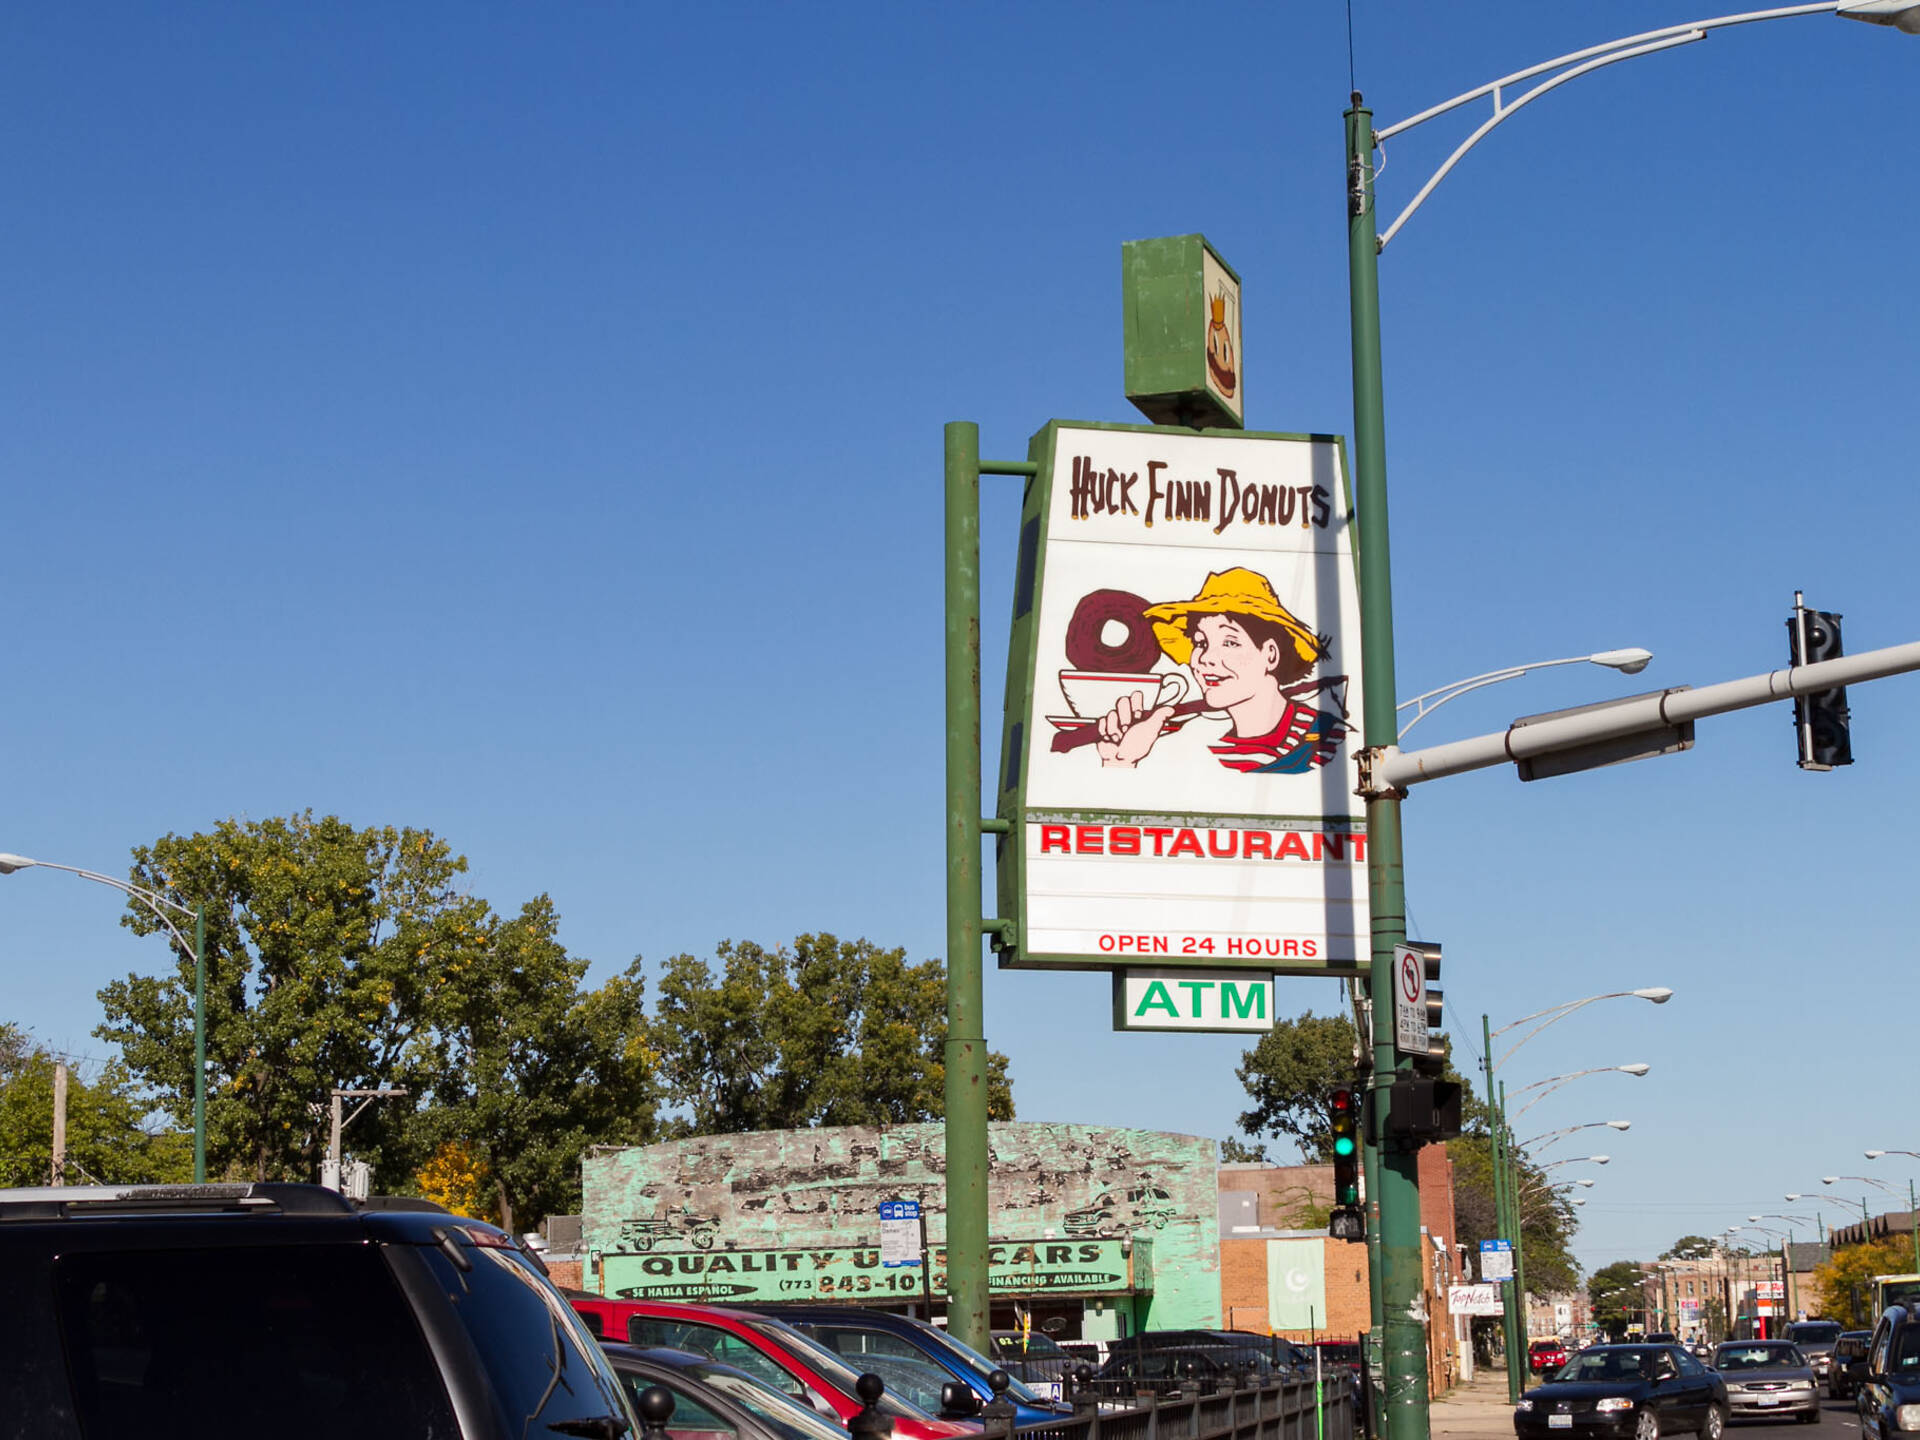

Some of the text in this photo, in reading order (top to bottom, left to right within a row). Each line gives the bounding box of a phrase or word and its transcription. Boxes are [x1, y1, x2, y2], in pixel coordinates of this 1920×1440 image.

[1070, 456, 1330, 534] HUCK FINN DONUTS
[1040, 824, 1367, 862] RESTAURANT
[1098, 934, 1318, 957] OPEN 24 HOURS
[1134, 980, 1266, 1019] ATM
[642, 1251, 835, 1276] QUALITY
[632, 1284, 734, 1297] SE HABLA ESPAÑOL
[818, 1273, 947, 1293] 843-102
[1053, 1273, 1111, 1284] AVAILABLE
